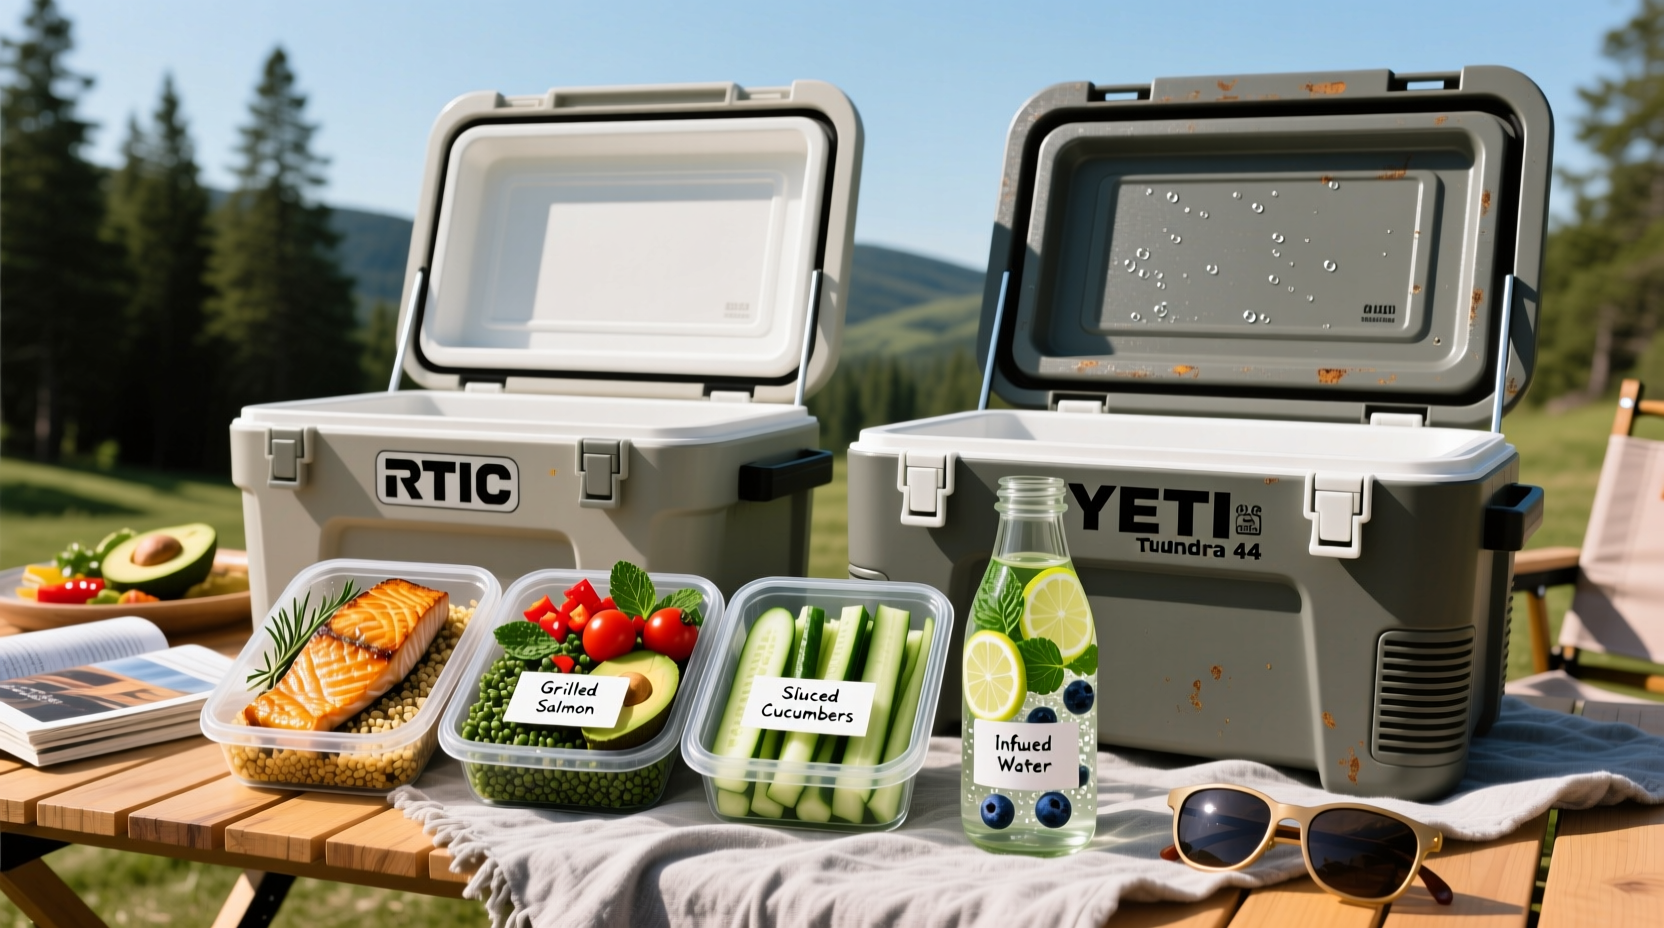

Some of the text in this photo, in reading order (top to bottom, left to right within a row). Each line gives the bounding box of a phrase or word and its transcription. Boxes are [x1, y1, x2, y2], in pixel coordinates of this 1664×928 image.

[385, 457, 512, 506] RTIC
[1068, 483, 1231, 539] YETI
[1136, 537, 1262, 560] Tuundra 44
[540, 680, 599, 697] Grilled
[535, 698, 595, 715] Salmon
[761, 702, 854, 723] Cucumbers
